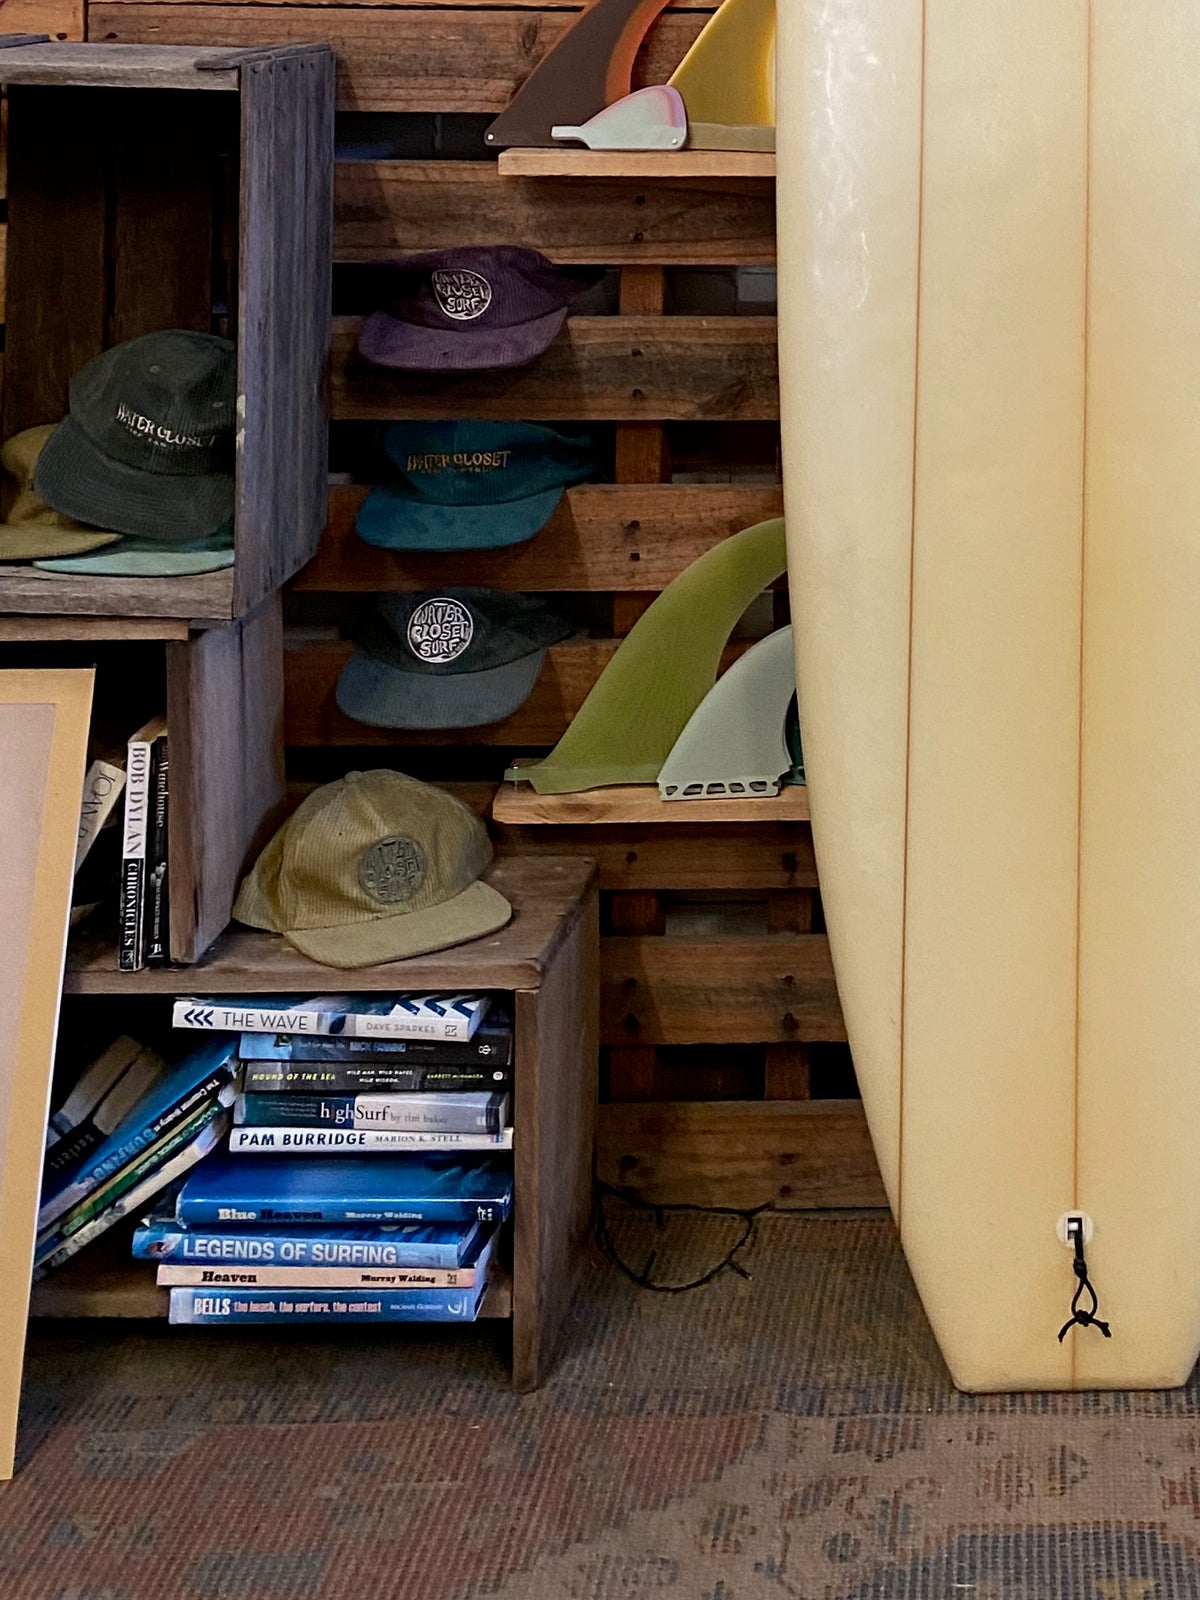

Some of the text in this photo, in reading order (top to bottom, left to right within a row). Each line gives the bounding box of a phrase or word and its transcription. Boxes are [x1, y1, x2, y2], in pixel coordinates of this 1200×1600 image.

[446, 297, 481, 312] SURF
[453, 450, 511, 468] CLOSET
[414, 603, 466, 625] WATER
[410, 621, 470, 643] CLOSET
[420, 638, 460, 656] SURF
[126, 747, 147, 854] BOB DYLAN
[123, 862, 138, 947] CHRONICLES
[222, 1011, 308, 1030] THE WAVE
[366, 1022, 394, 1032] DAVE
[252, 1073, 336, 1081] HOUND OF THE SEA
[239, 1133, 367, 1146] PAM BURRIDGE
[375, 1134, 416, 1143] MARION
[218, 1209, 323, 1220] Blue Heaven
[183, 1238, 275, 1260] LEGENDS
[280, 1242, 307, 1261] OF
[311, 1243, 397, 1265] SURFING
[202, 1271, 257, 1283] Heaven
[361, 1275, 436, 1284] Murray Walding
[194, 1298, 231, 1315] BELLS
[333, 1301, 347, 1312] the
